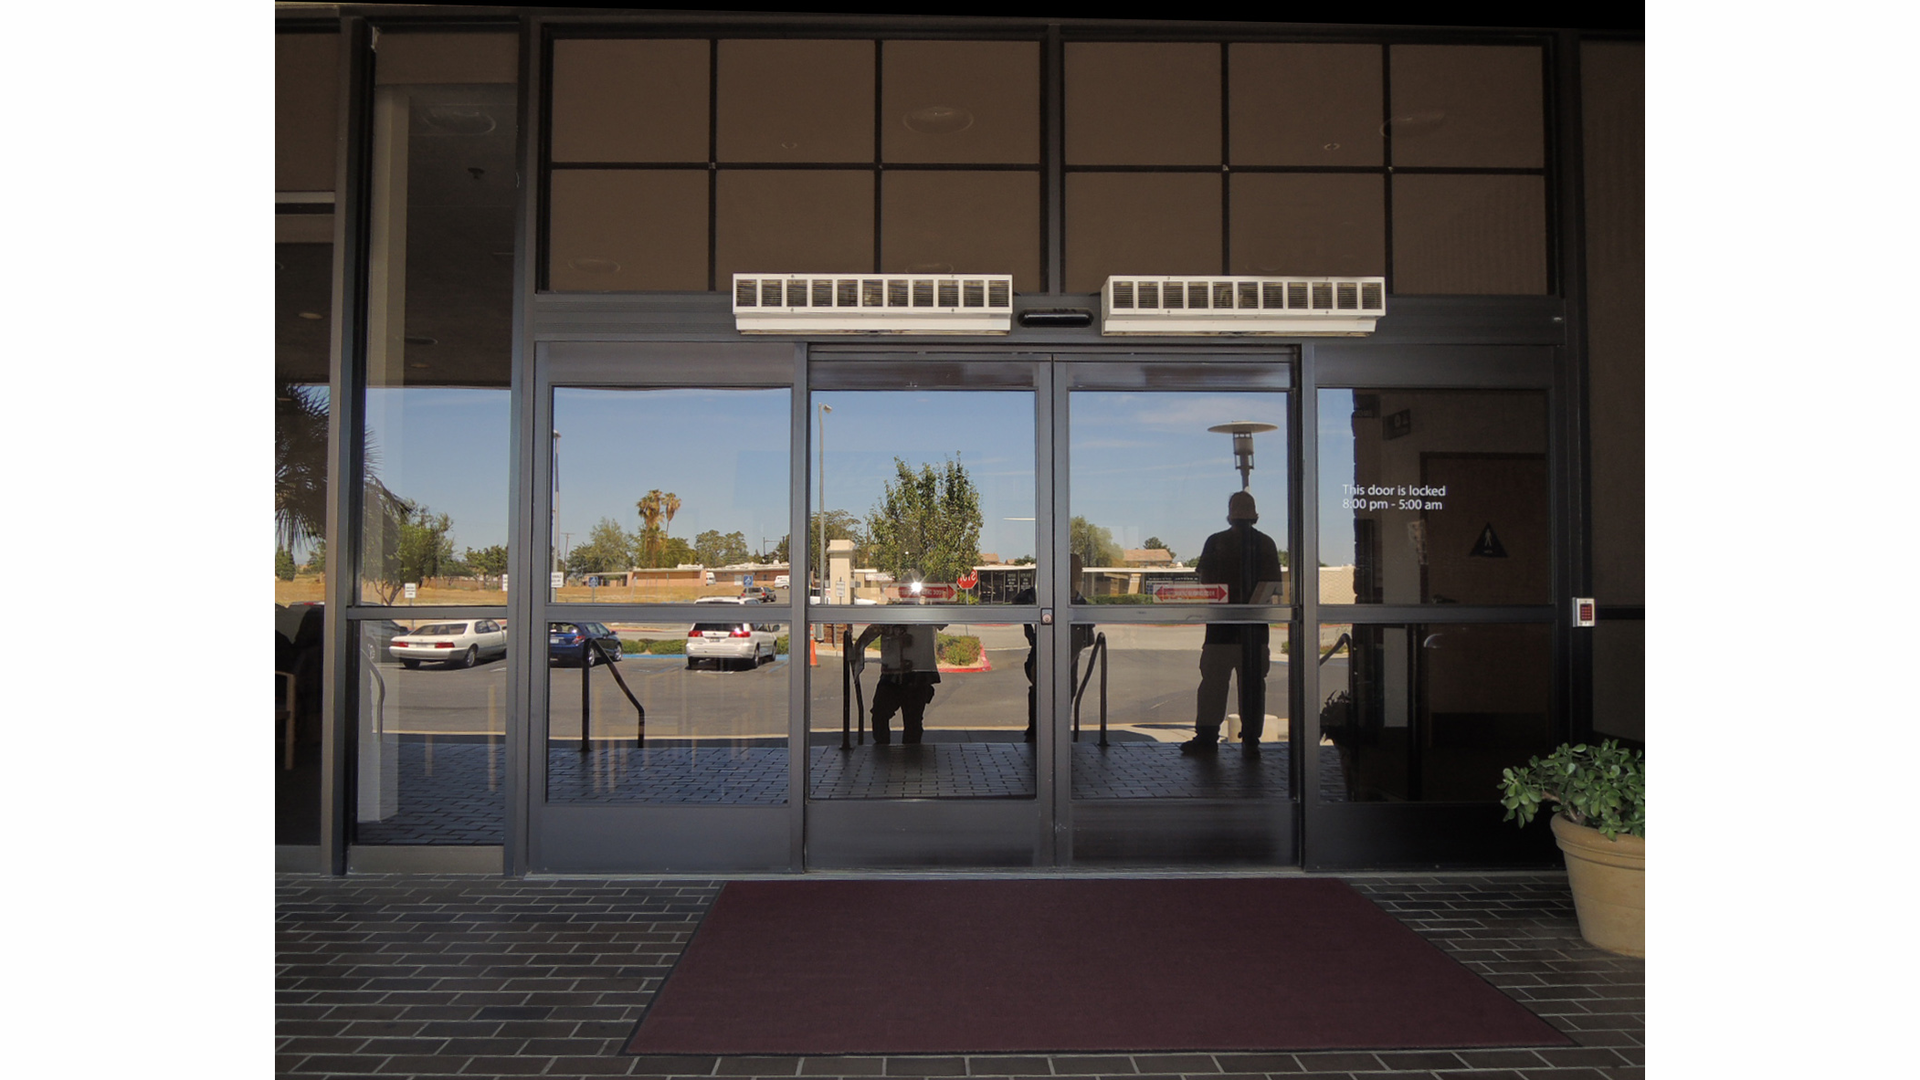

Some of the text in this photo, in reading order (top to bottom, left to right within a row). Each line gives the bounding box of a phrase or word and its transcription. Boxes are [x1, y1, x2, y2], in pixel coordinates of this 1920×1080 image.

[1342, 484, 1446, 497] This door is locked
[1342, 499, 1366, 509] 8:00
[1369, 501, 1388, 512] pm
[1399, 499, 1422, 510] 5:00
[1425, 501, 1442, 510] am
